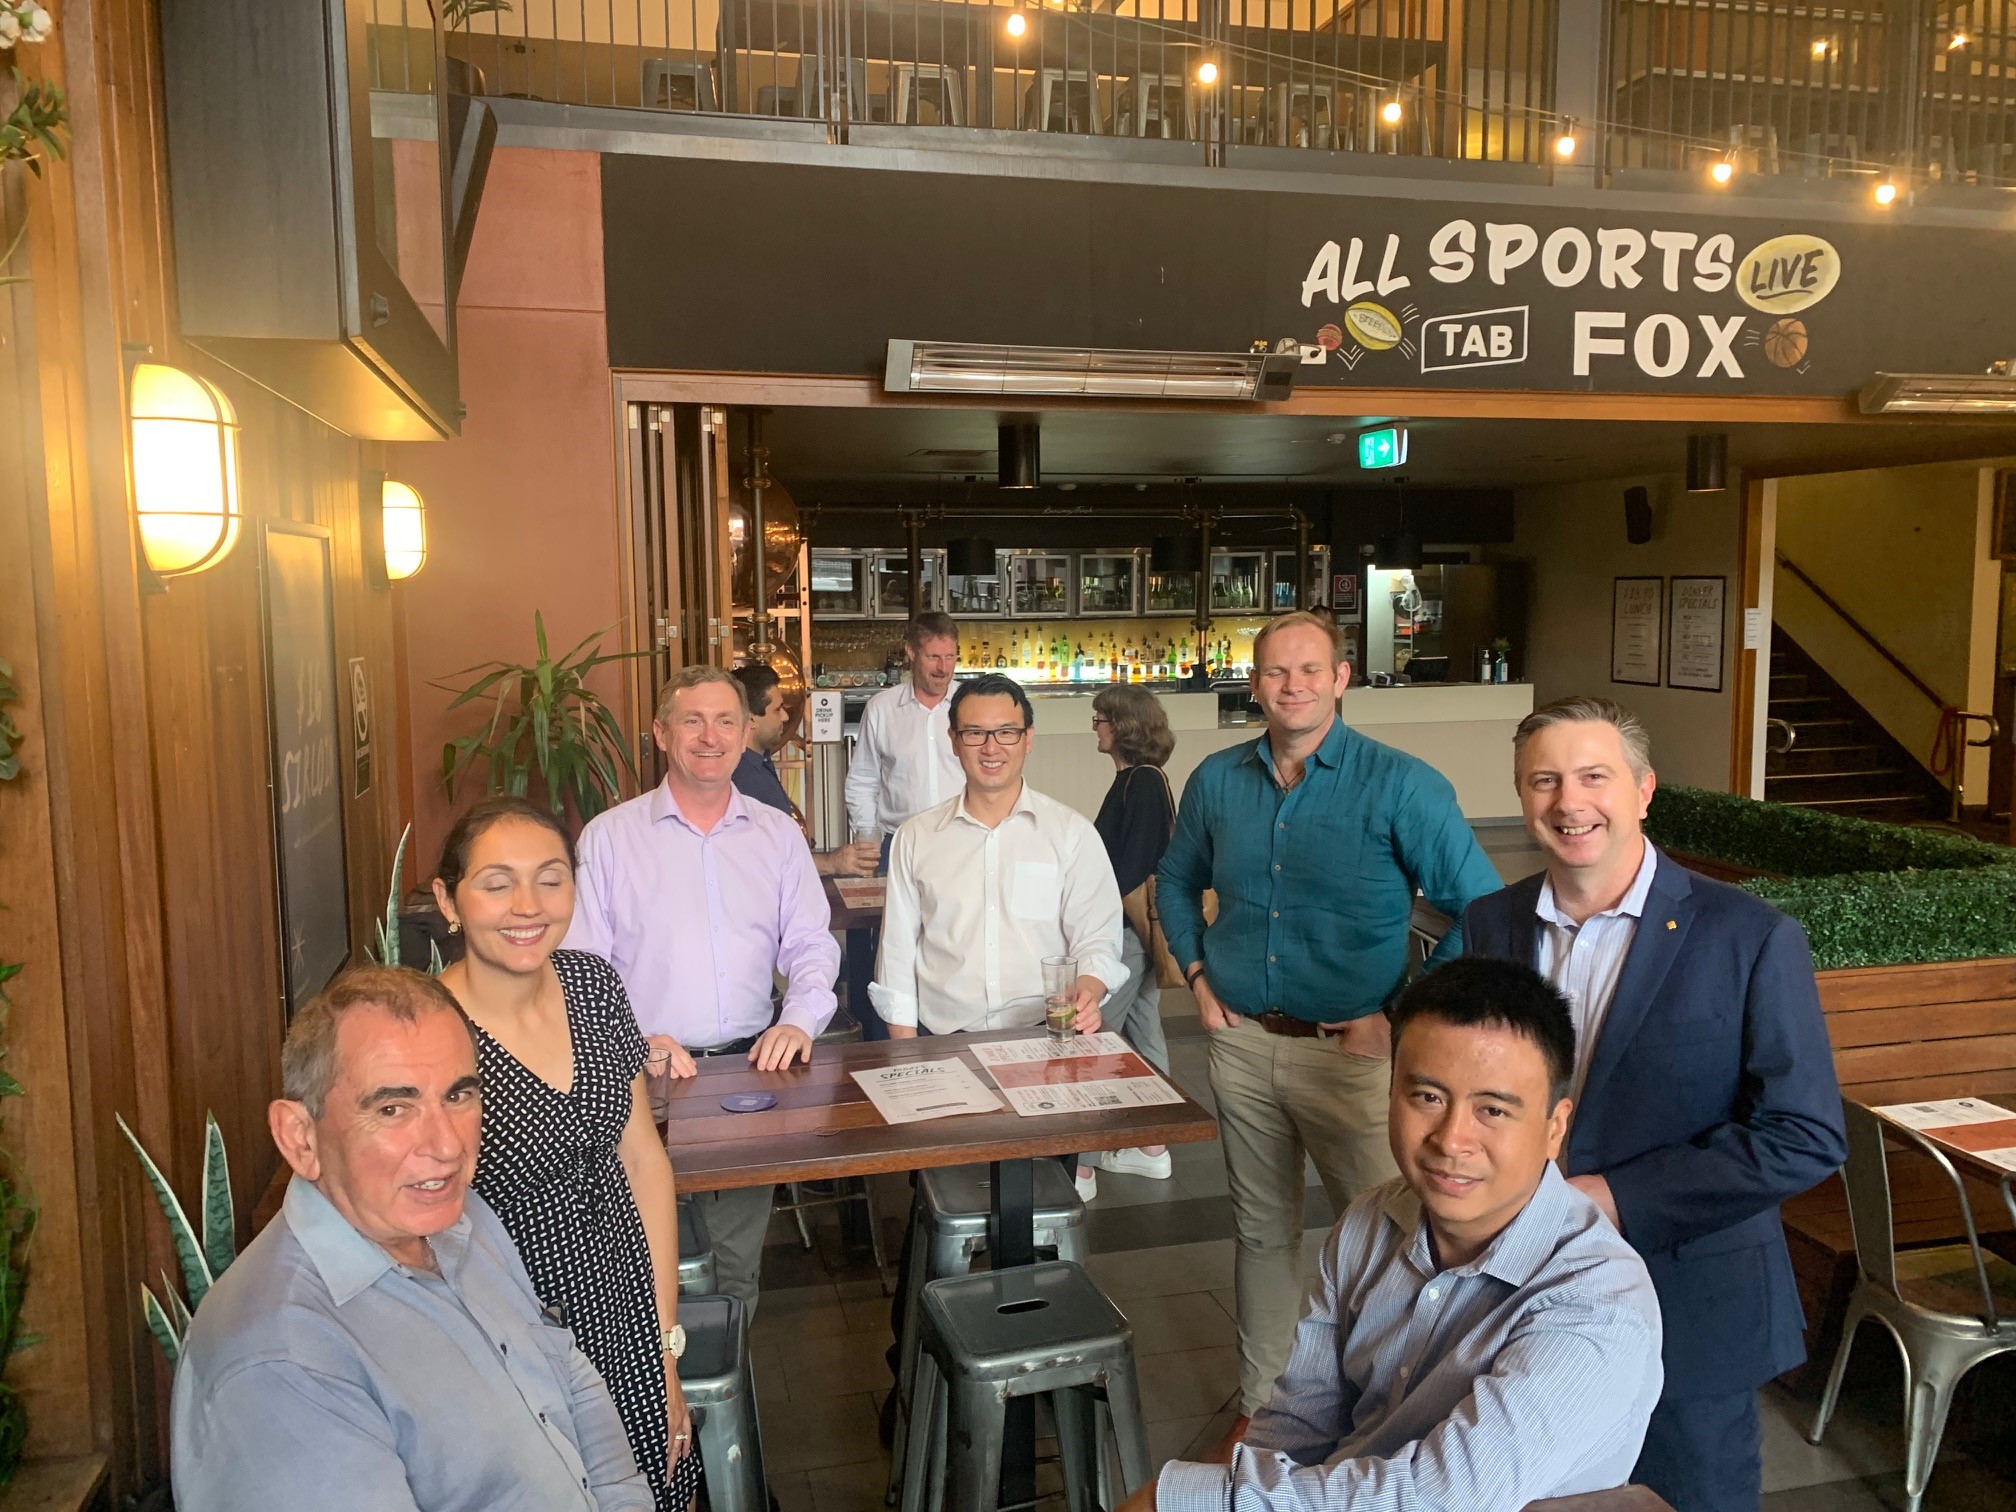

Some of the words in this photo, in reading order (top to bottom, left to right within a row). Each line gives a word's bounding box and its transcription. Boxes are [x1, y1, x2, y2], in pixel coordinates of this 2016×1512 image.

[1302, 234, 1411, 307] ALL
[1428, 219, 1734, 293] SPORTS
[1750, 249, 1825, 293] LIVE
[1439, 324, 1513, 358] TAB
[1573, 311, 1746, 379] FOX
[880, 1067, 946, 1080] SPECIALS
